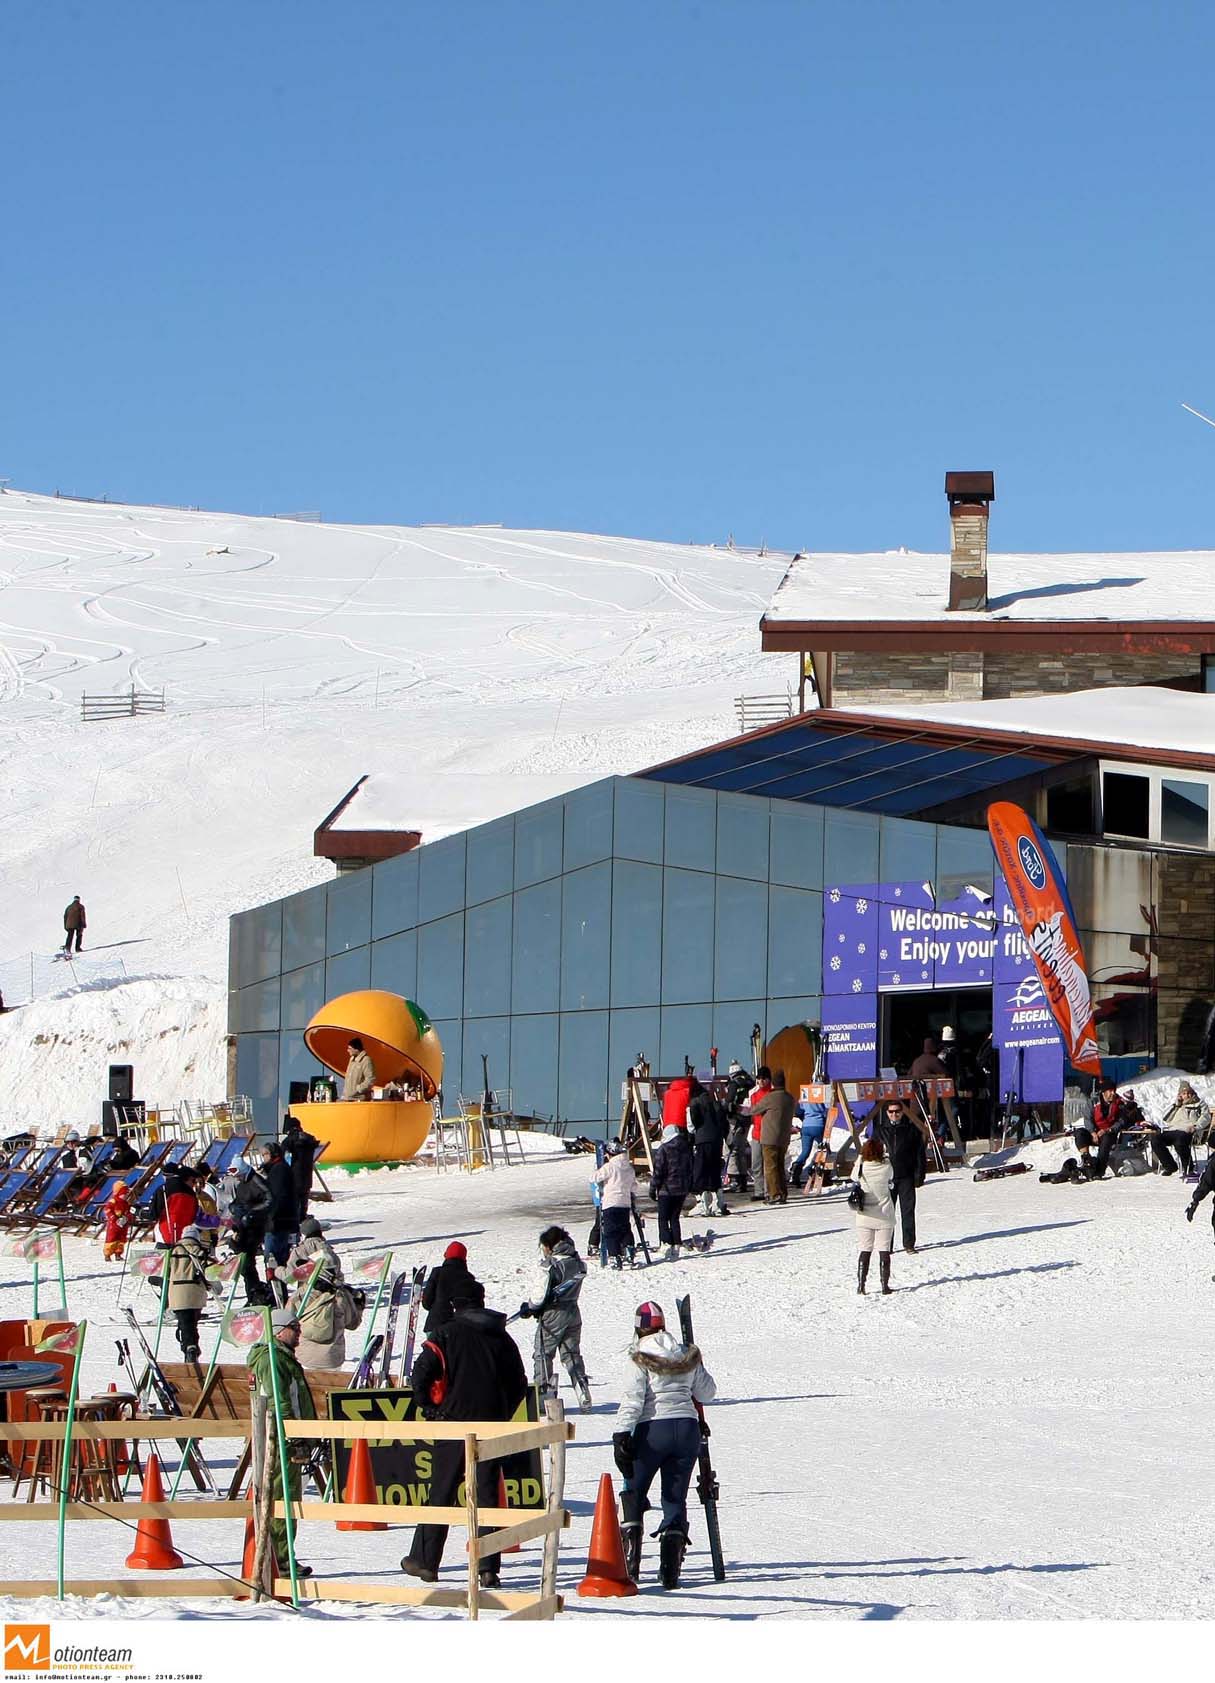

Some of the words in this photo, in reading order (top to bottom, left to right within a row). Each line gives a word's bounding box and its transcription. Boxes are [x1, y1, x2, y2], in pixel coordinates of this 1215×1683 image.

[890, 909, 969, 931] Welcome
[901, 937, 951, 965] Enjoy
[956, 938, 998, 964] your
[1011, 1009, 1053, 1024] AEGEAN
[823, 1033, 850, 1042] EGEAN
